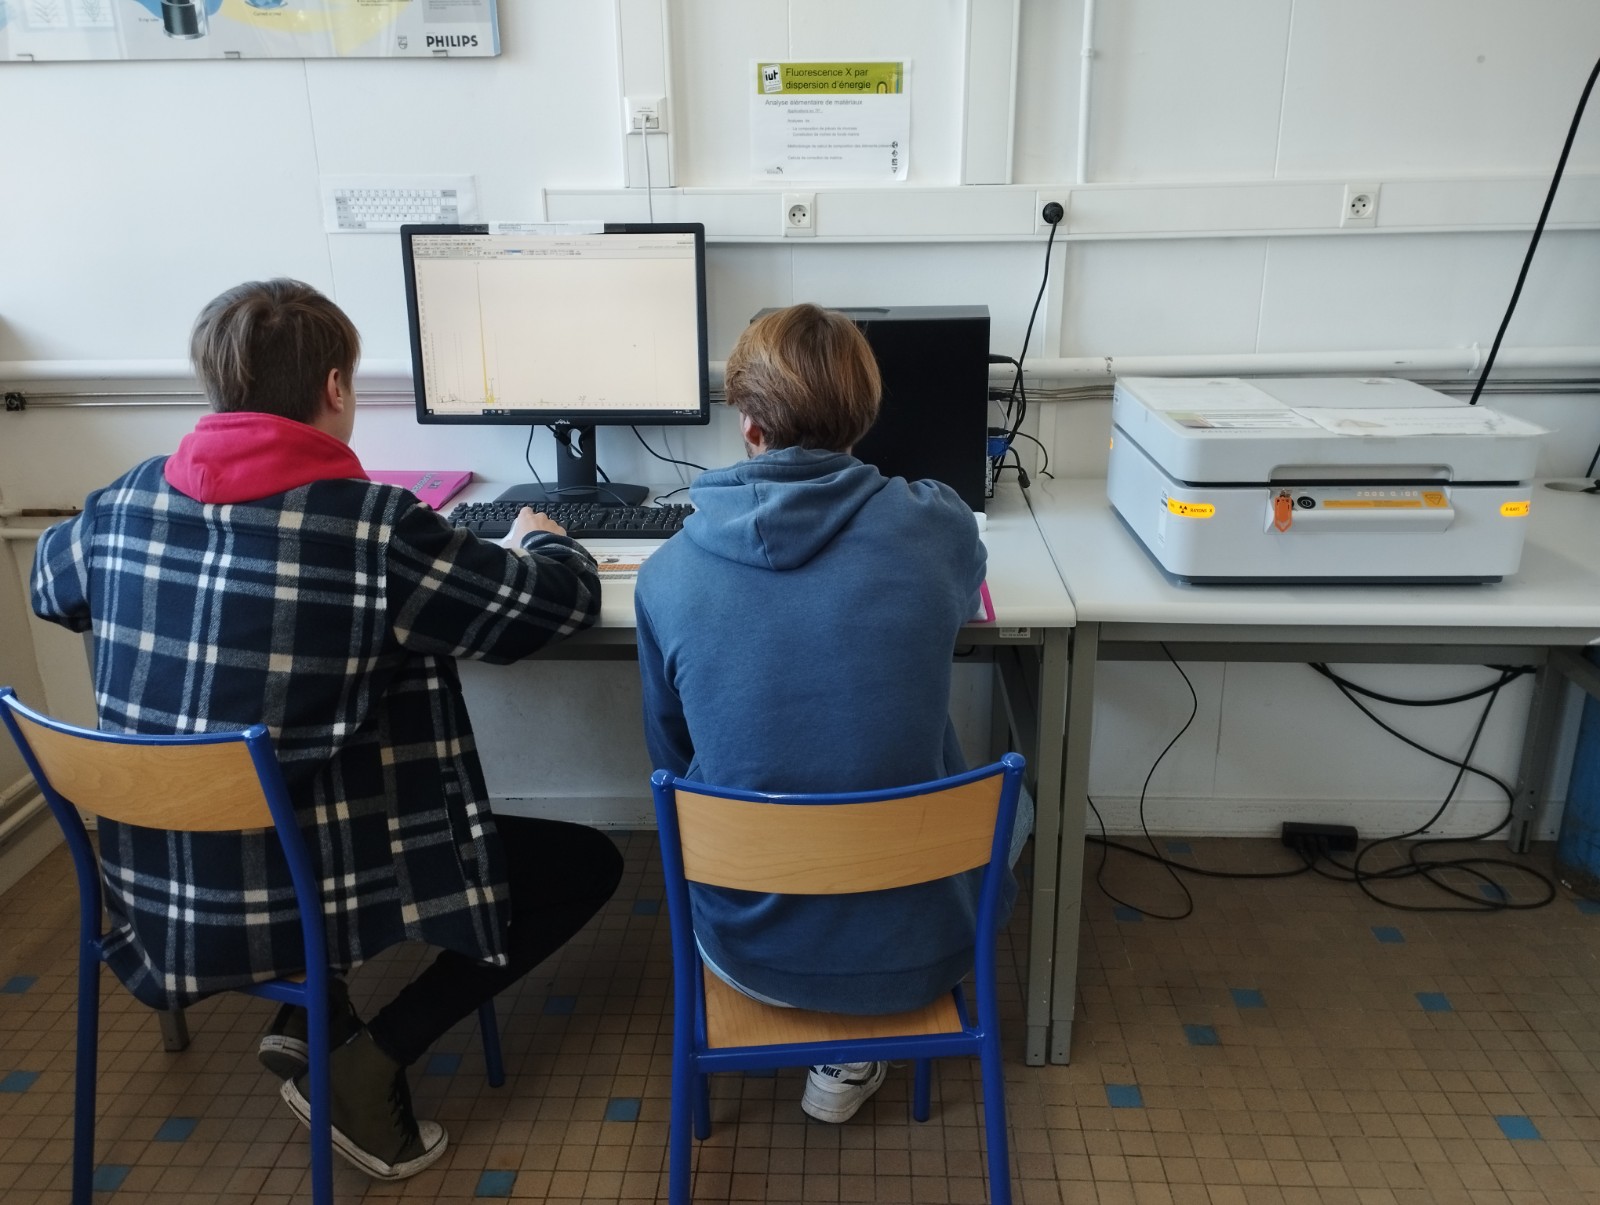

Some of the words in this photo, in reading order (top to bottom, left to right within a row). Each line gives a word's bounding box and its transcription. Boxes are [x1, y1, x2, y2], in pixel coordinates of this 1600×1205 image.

[426, 35, 478, 47] PHILIPS
[765, 69, 778, 81] iut
[785, 68, 843, 77] Fluorescence
[845, 68, 852, 77] X
[854, 69, 868, 78] par
[785, 81, 829, 90] dispersion
[831, 80, 871, 90] d'énergie
[765, 99, 789, 107] Analyse
[820, 1065, 842, 1078] NIKE
